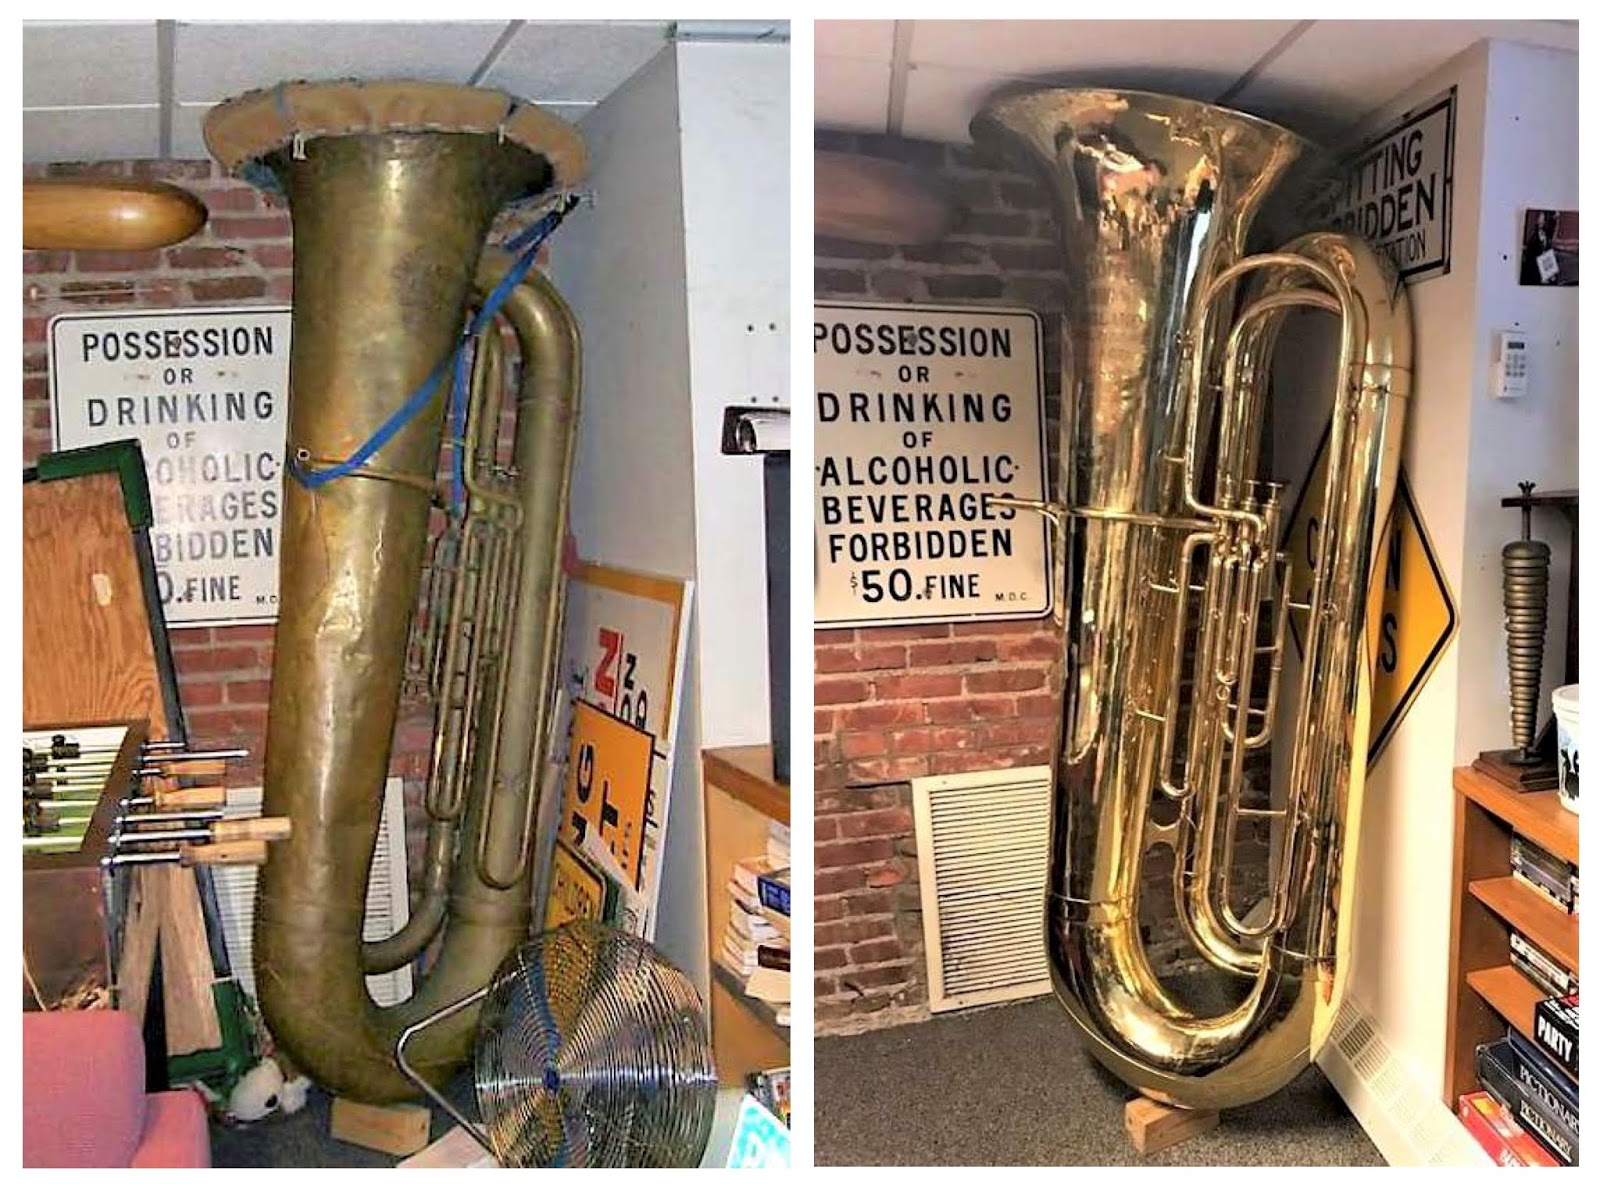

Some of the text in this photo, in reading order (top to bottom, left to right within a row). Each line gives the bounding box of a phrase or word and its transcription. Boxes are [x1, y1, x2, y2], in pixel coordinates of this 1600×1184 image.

[83, 327, 273, 362] POSSESSION
[814, 323, 1012, 357] POSSESSION
[164, 368, 193, 385] OR
[898, 365, 929, 383] OR
[88, 391, 273, 426] DRINKING
[817, 392, 1012, 423] DRINKING
[166, 431, 196, 449] OF
[902, 431, 932, 449] OF
[156, 452, 275, 484] OHOLIC
[820, 455, 1014, 486] ALCOHOLIC
[155, 490, 277, 525] ERAGES
[822, 493, 1016, 525] BEVERAGES
[155, 528, 274, 562] BIDDEN
[829, 529, 1012, 563] FORBIDDEN
[186, 576, 240, 602] FINE
[925, 574, 980, 599] FINE
[1538, 1014, 1573, 1062] PARTY
[1519, 1065, 1579, 1135] PICTIONAR
